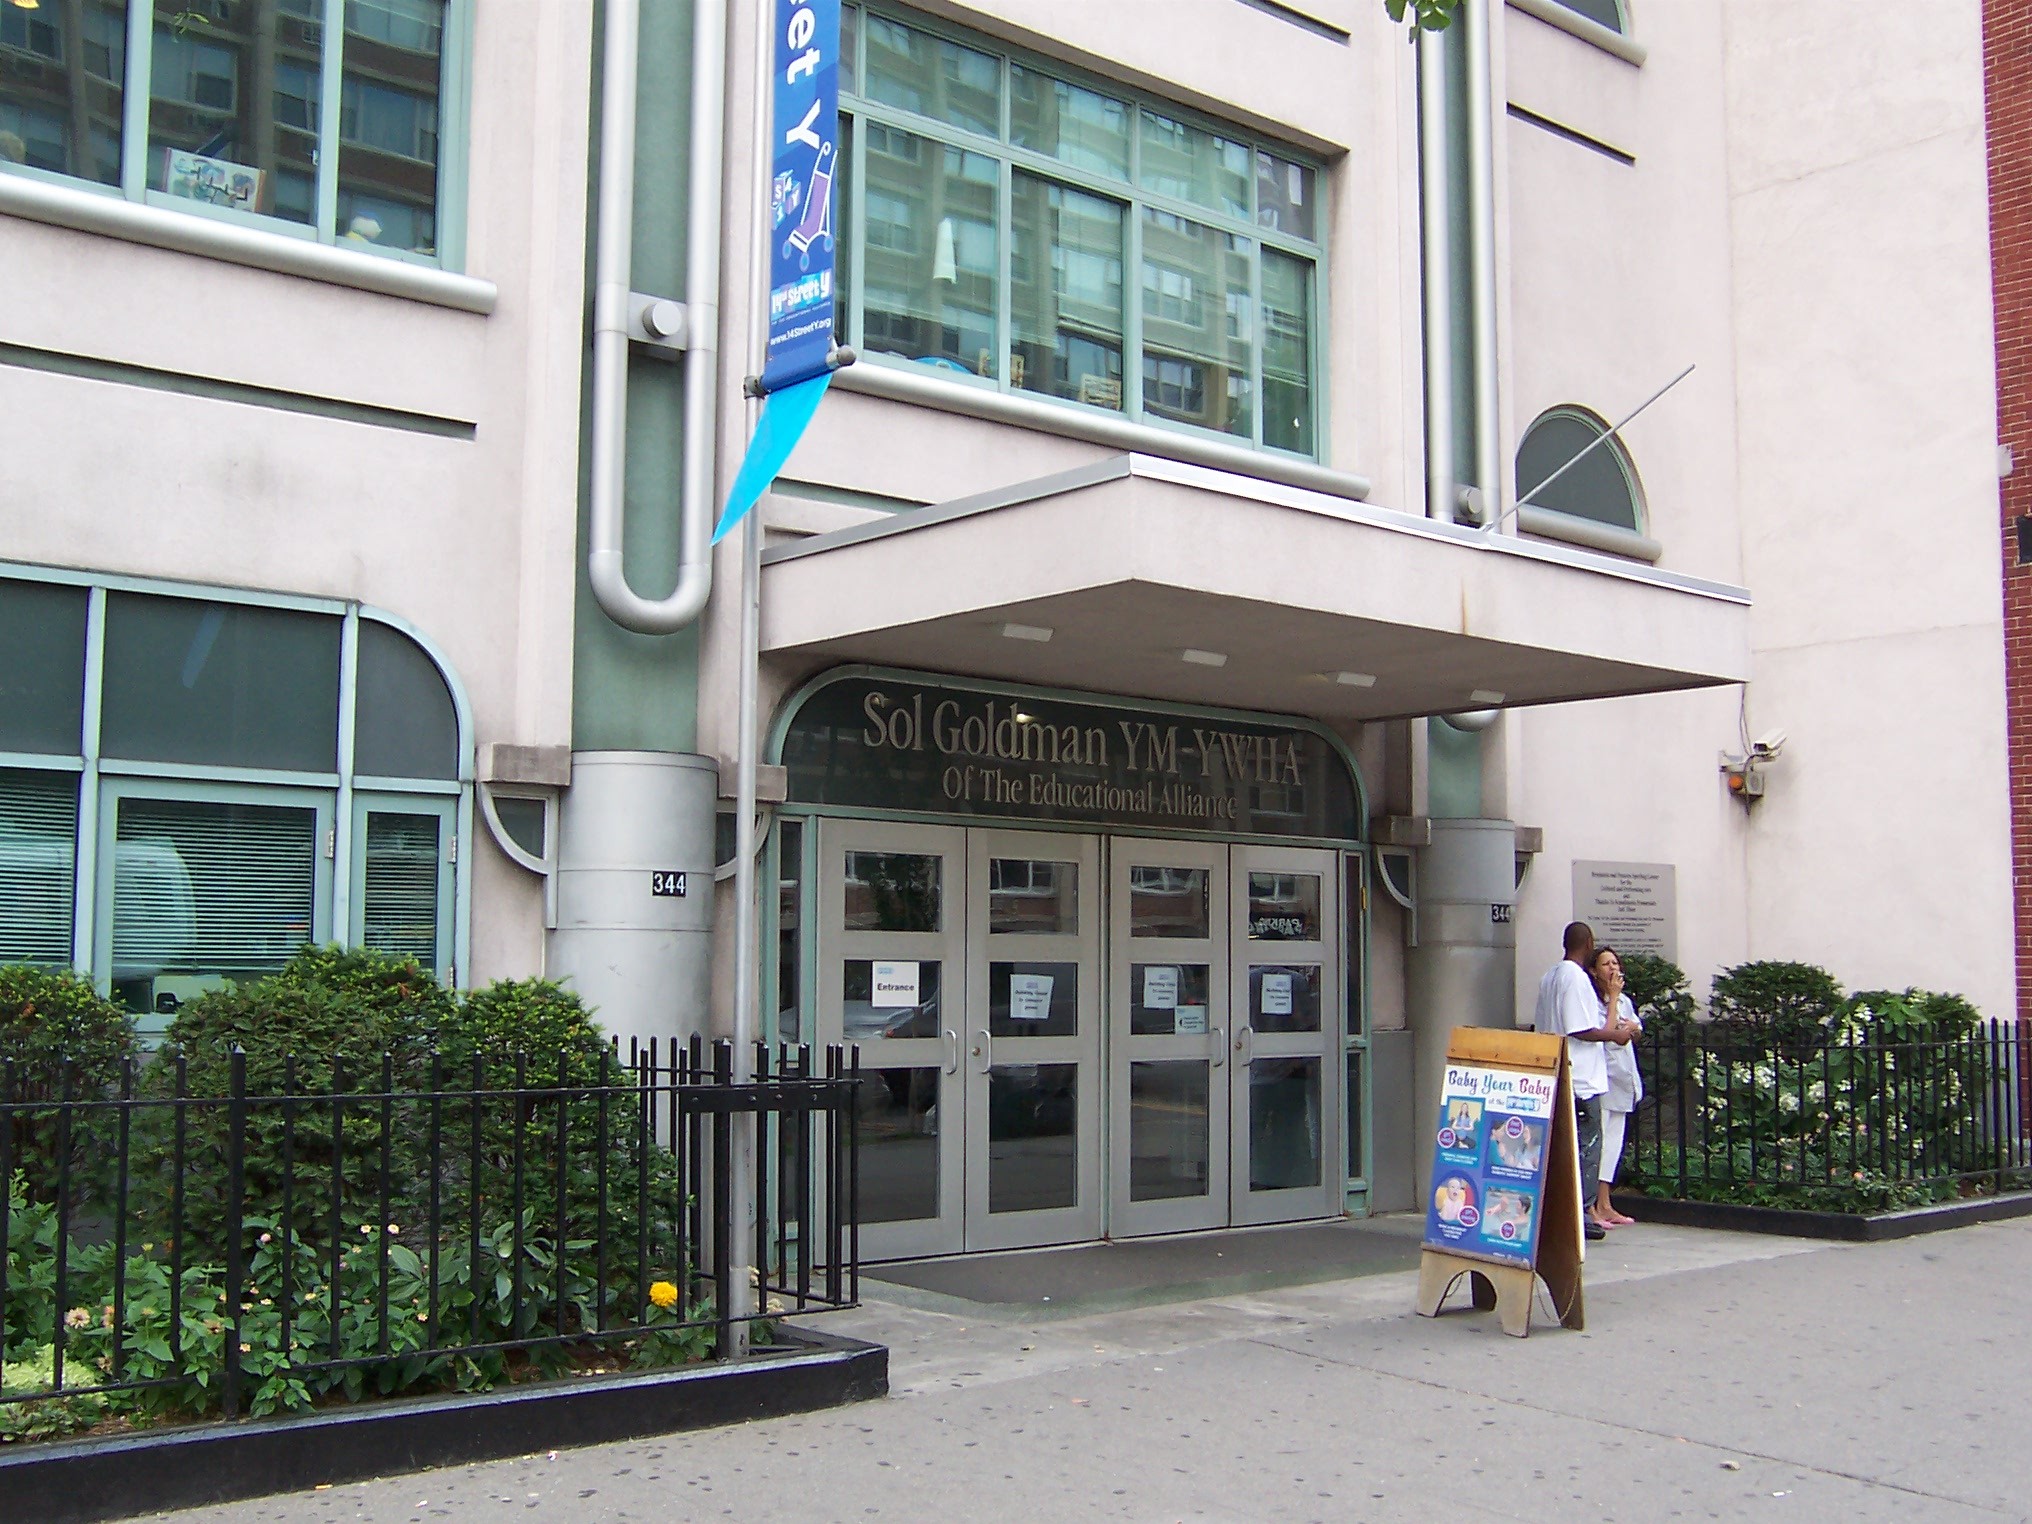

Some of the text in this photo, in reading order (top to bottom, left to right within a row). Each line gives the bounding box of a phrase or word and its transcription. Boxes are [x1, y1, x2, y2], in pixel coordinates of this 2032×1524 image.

[783, 0, 821, 150] et Y
[863, 691, 1302, 786] Sol Goldman YM-YWHA
[942, 765, 1237, 819] Of The Educational Alliance
[653, 872, 686, 895] 344
[1492, 905, 1511, 921] 344
[877, 982, 915, 992] Entrance
[1448, 1069, 1478, 1095] Baby
[1481, 1073, 1514, 1095] Your
[1519, 1077, 1551, 1104] Baby
